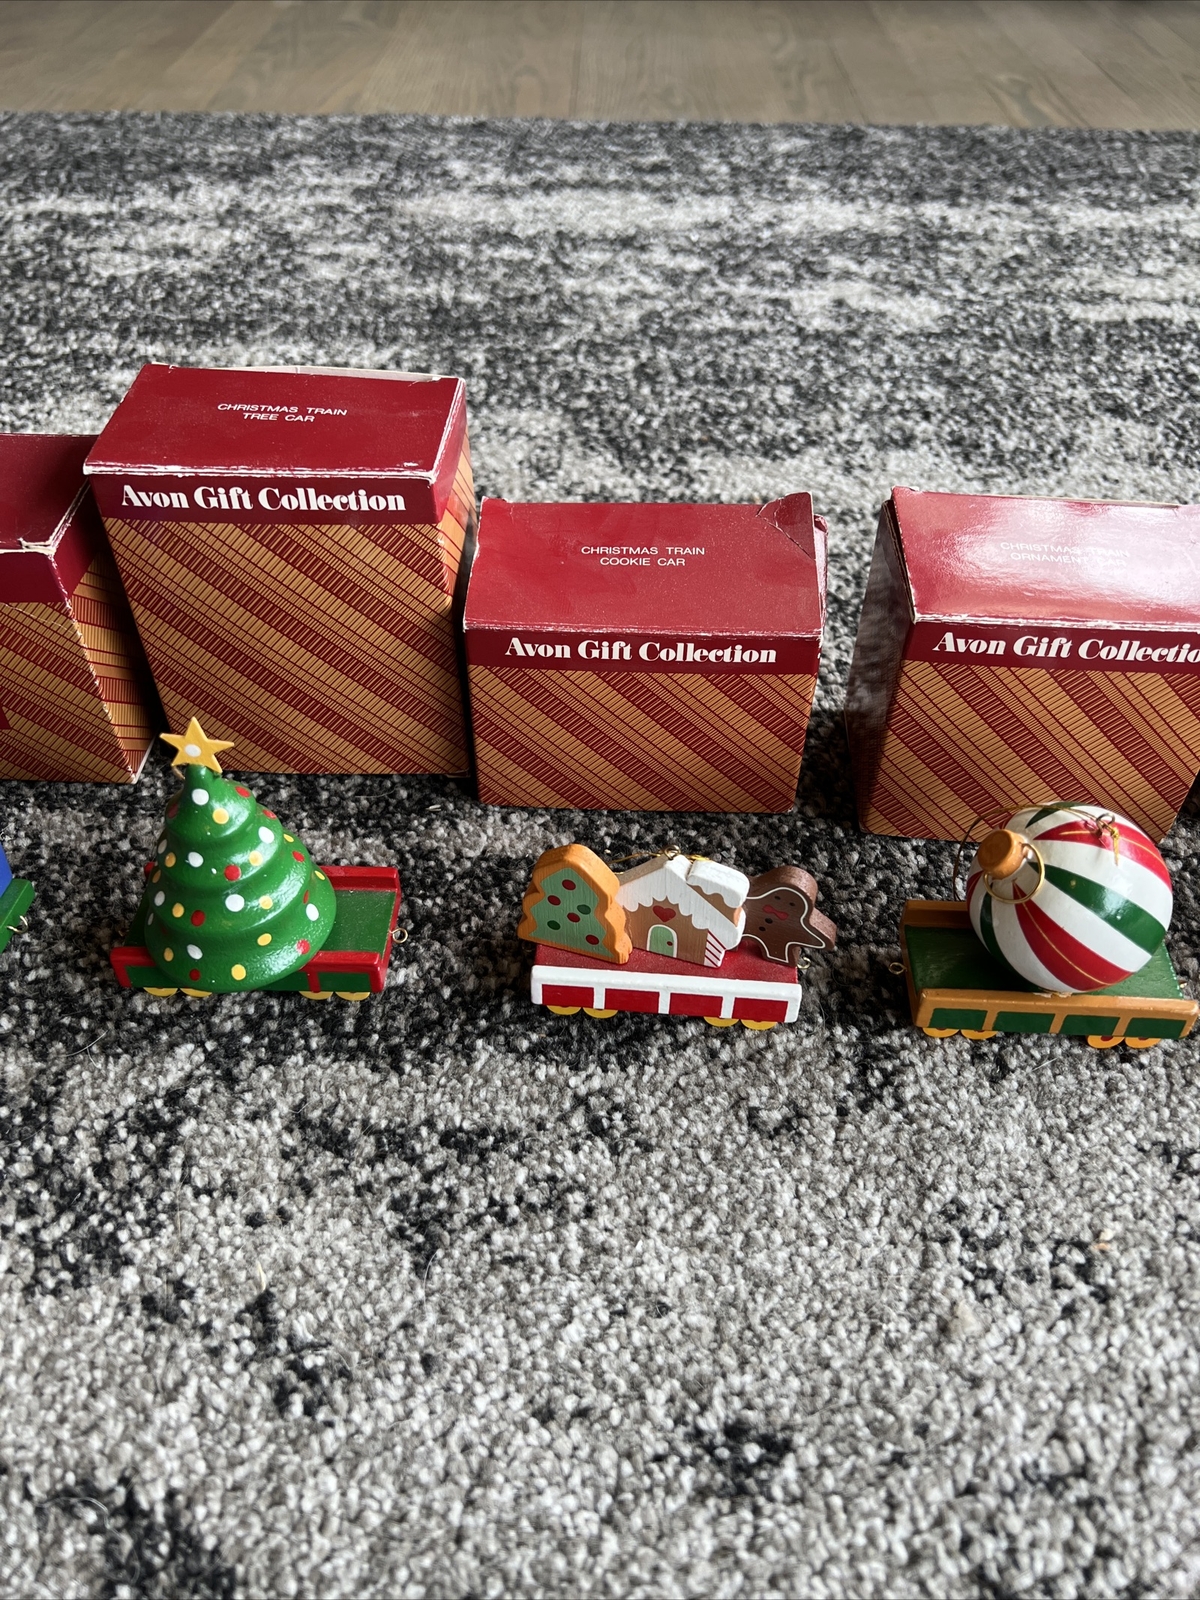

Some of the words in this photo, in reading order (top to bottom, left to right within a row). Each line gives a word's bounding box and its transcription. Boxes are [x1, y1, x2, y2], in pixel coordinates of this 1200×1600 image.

[217, 403, 298, 413] CHRISTMAS
[306, 407, 348, 416] TRAIN
[243, 412, 278, 421] TREE
[284, 414, 315, 422] CAR
[121, 484, 190, 508] Avon
[193, 486, 253, 510] Gift
[258, 487, 406, 511] Collection
[580, 545, 659, 555] CHRISTMAS
[665, 546, 706, 556] TRAIN
[1000, 541, 1081, 554] CHRISTMAS
[599, 556, 651, 566] COOKIE
[657, 557, 686, 567] CAR
[1010, 552, 1088, 564] ORNAMENT
[505, 637, 571, 660] Avon
[577, 640, 632, 661] Gift
[638, 642, 777, 664] Collection
[932, 631, 1006, 656] Avon
[1013, 635, 1073, 659] Gift
